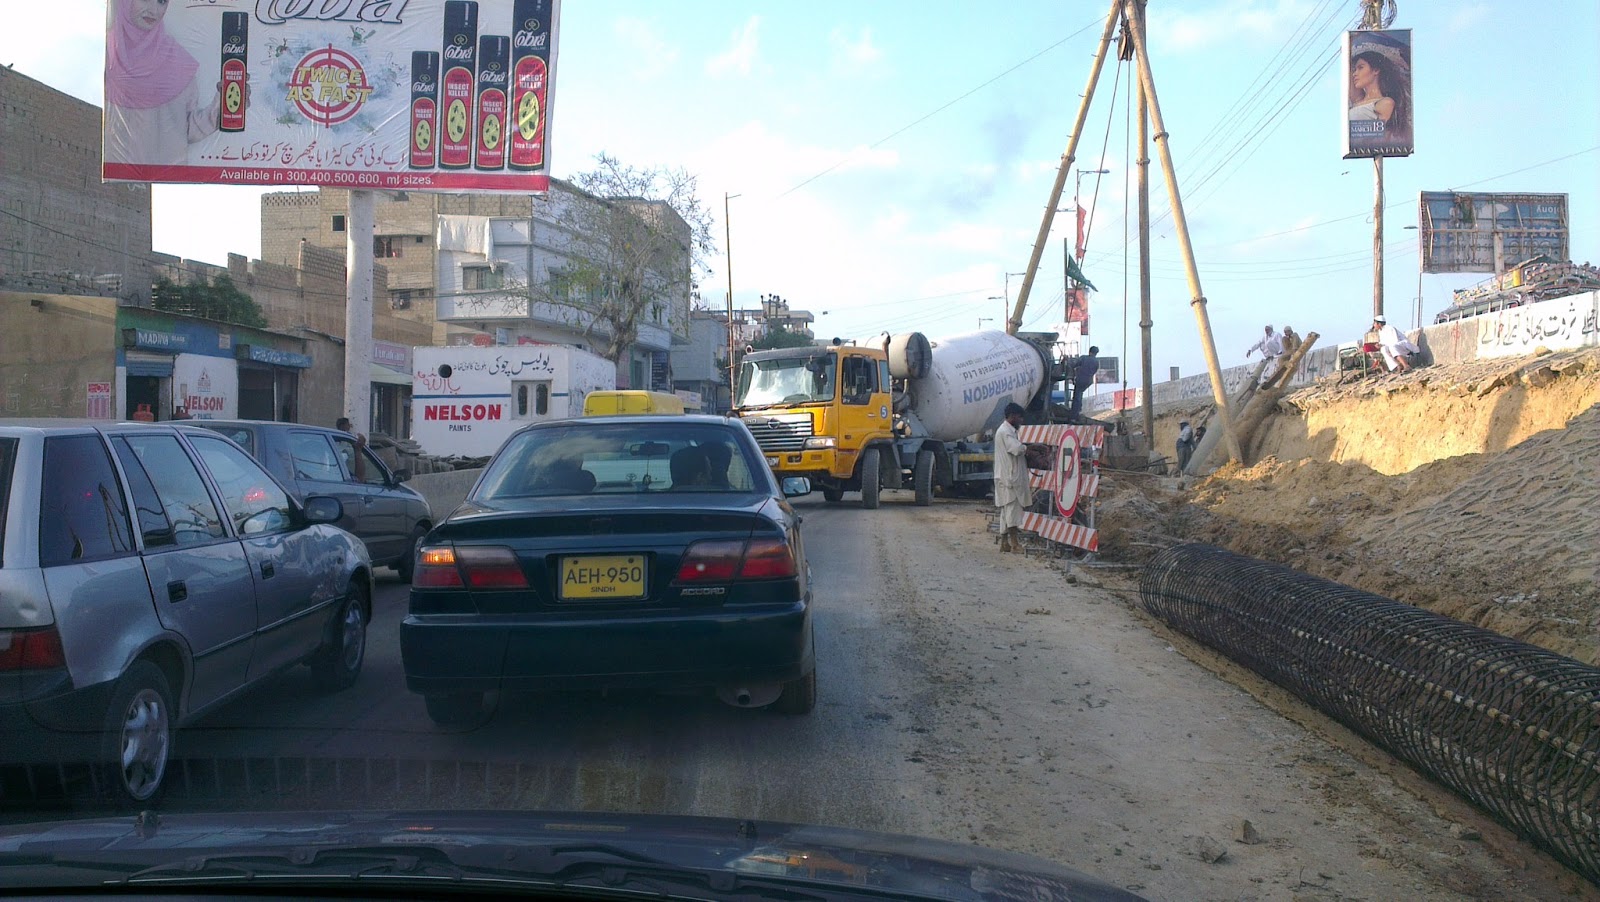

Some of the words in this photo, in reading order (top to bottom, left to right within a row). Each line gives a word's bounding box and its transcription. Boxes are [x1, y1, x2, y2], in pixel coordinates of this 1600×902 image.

[514, 30, 547, 48] Cobra
[222, 43, 245, 54] Cobra
[444, 44, 474, 60] Cobra
[298, 66, 363, 84] TWICE
[480, 69, 506, 82] Cobra
[412, 81, 435, 93] Cobra
[447, 83, 470, 91] INSECT
[448, 89, 469, 97] KILLER
[520, 81, 542, 89] KILLER
[285, 86, 314, 101] AS
[319, 86, 373, 104] FAST
[1373, 121, 1384, 132] 18
[325, 142, 352, 167] کیڑا
[345, 143, 366, 167] بھی
[363, 142, 390, 167] کوئی
[383, 152, 405, 171] اب
[220, 169, 270, 180] Available
[273, 171, 283, 180] in
[386, 174, 400, 184] ml
[403, 175, 434, 185] sizes.
[138, 332, 169, 346] MADINA
[489, 355, 511, 377] چوکی
[511, 352, 554, 375] پولیس
[978, 360, 1007, 375] Concrete
[184, 395, 224, 411] NELSON
[424, 403, 502, 421] NELSON
[881, 406, 887, 418] 5
[449, 424, 472, 432] PAINTS
[565, 566, 642, 585] AEH-950
[680, 587, 726, 597] ACCORD
